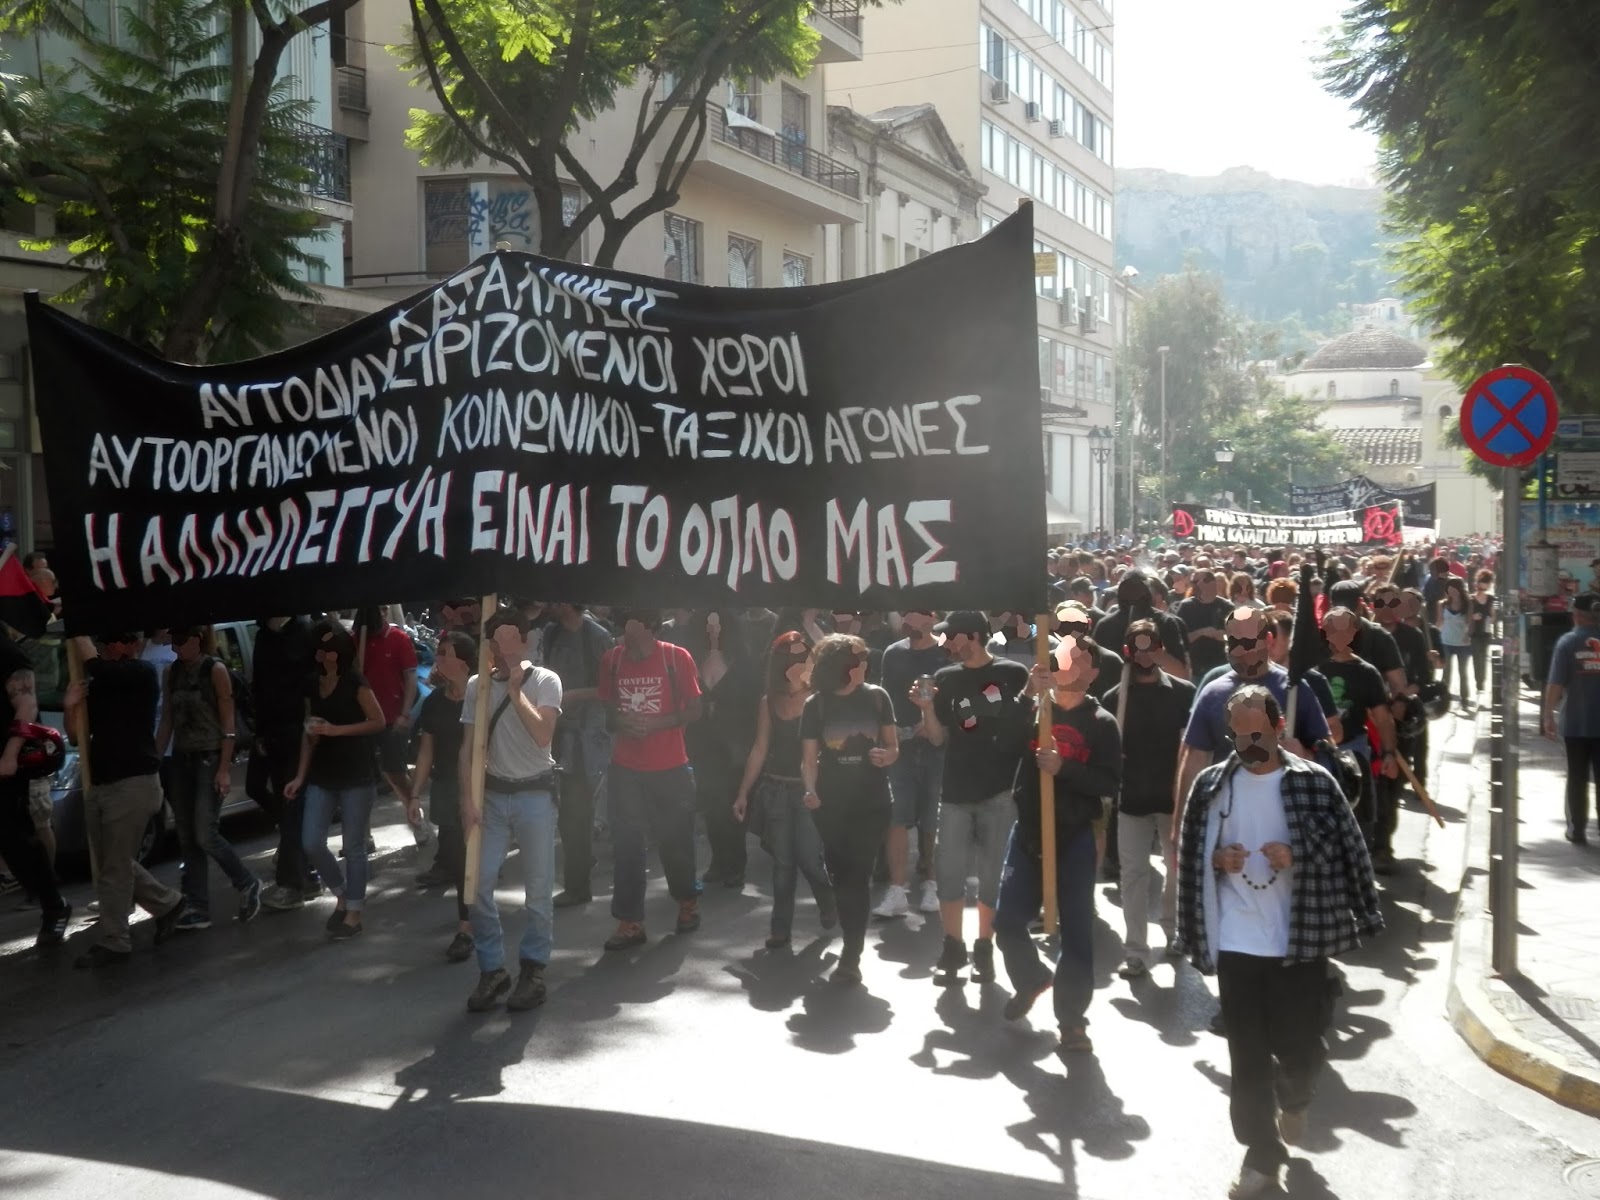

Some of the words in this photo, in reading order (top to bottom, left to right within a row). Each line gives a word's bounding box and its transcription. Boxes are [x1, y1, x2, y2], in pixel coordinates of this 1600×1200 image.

[693, 331, 809, 398] ΧΩΡΟΙ
[825, 394, 990, 465] ΑΓΩΝΕΣ
[85, 512, 128, 590] Η
[141, 465, 453, 588] ΑΛΛΗΛΕΓΓΥΗ
[471, 470, 590, 566] ΕΙΝΑΙ
[609, 484, 671, 572] ΤΟ
[679, 494, 800, 593] ΟΠΛΟ
[825, 497, 960, 595] ΜΑΣ
[618, 677, 663, 686] CONFLICT
